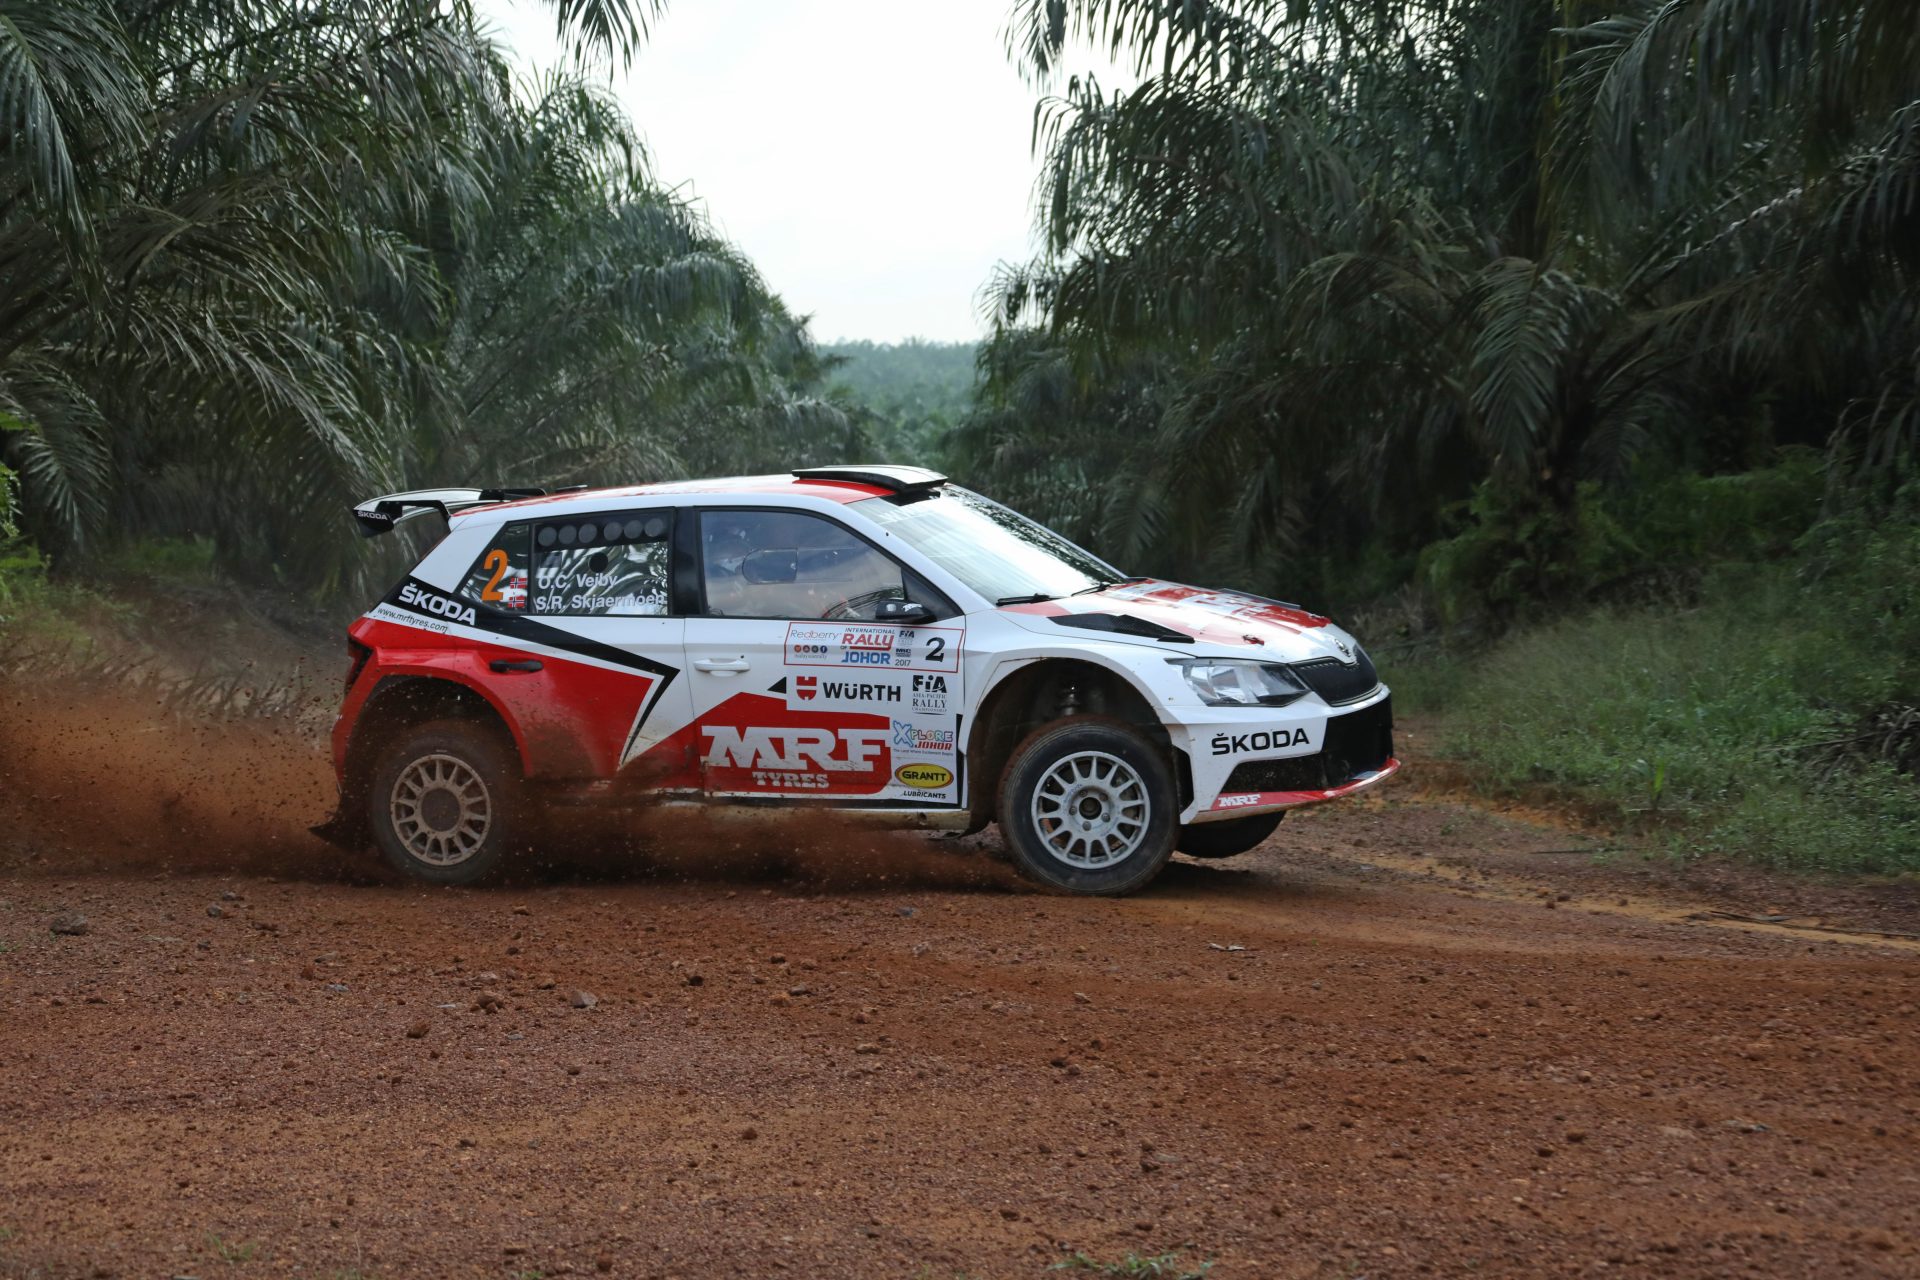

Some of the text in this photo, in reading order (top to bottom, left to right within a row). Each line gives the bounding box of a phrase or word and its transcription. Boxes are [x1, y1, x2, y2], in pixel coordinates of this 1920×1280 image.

[481, 549, 508, 601] 2
[576, 573, 618, 589] Veiby
[398, 582, 476, 626] ŠKODA
[536, 596, 567, 611] S.R.
[377, 607, 448, 634] www.mrftyres.com
[791, 629, 838, 640] Redberry
[845, 627, 895, 635] INTERNATIONAL
[925, 636, 946, 663] 2
[841, 651, 891, 665] JOHOR
[895, 659, 911, 667] 2017
[912, 698, 947, 709] RALLY
[700, 725, 890, 772] MRF
[1211, 728, 1310, 755] ŠKODA
[752, 771, 829, 788] TYRES
[902, 771, 946, 782] GRANTT
[903, 790, 946, 800] LUBRICANTS
[1218, 794, 1260, 806] MRF
